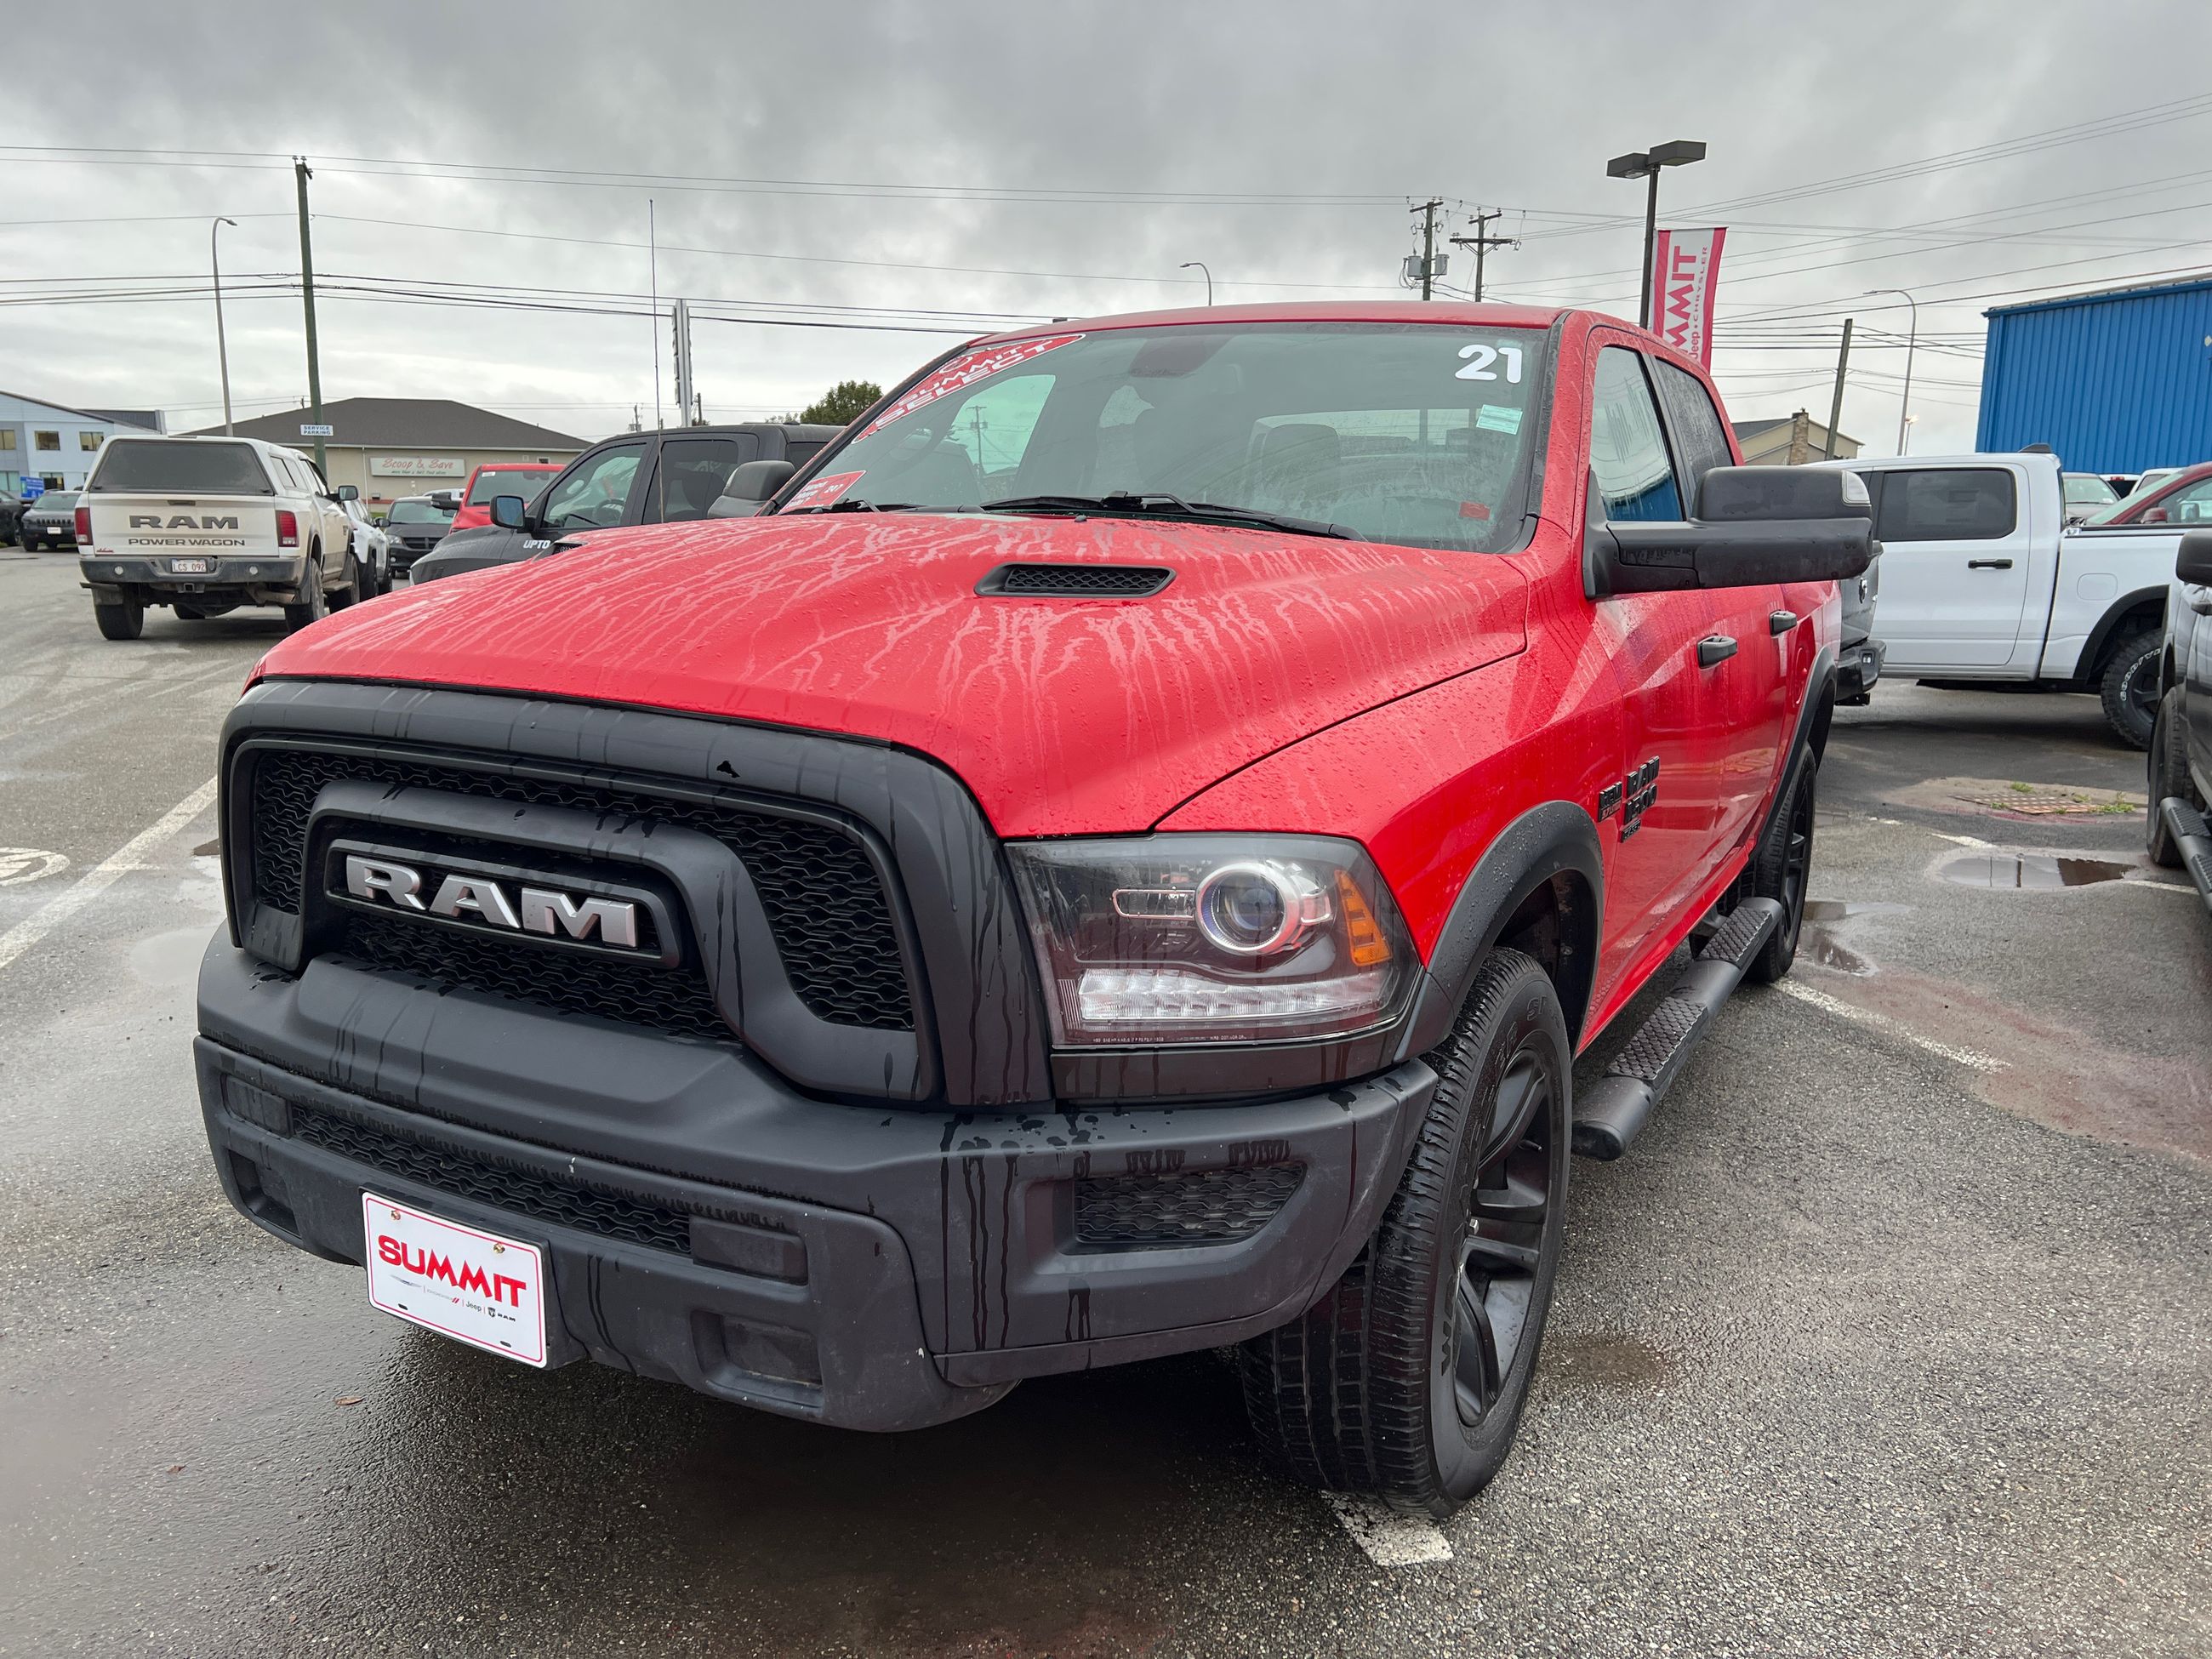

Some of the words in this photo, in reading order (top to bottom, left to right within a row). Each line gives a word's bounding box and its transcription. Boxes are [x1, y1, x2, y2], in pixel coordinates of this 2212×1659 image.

[1693, 247, 1707, 322] CHRYSLER
[1455, 344, 1523, 384] 21
[1689, 332, 1701, 360] Jeep
[875, 340, 1053, 426] SELECT
[898, 345, 1023, 407] SUMMIT
[382, 459, 413, 470] Scoop
[416, 458, 425, 469] &
[429, 459, 453, 469] Save
[129, 515, 238, 529] RAM
[346, 854, 638, 949] RAM
[378, 1234, 527, 1308] SUMMIT
[466, 1301, 482, 1312] Jeep
